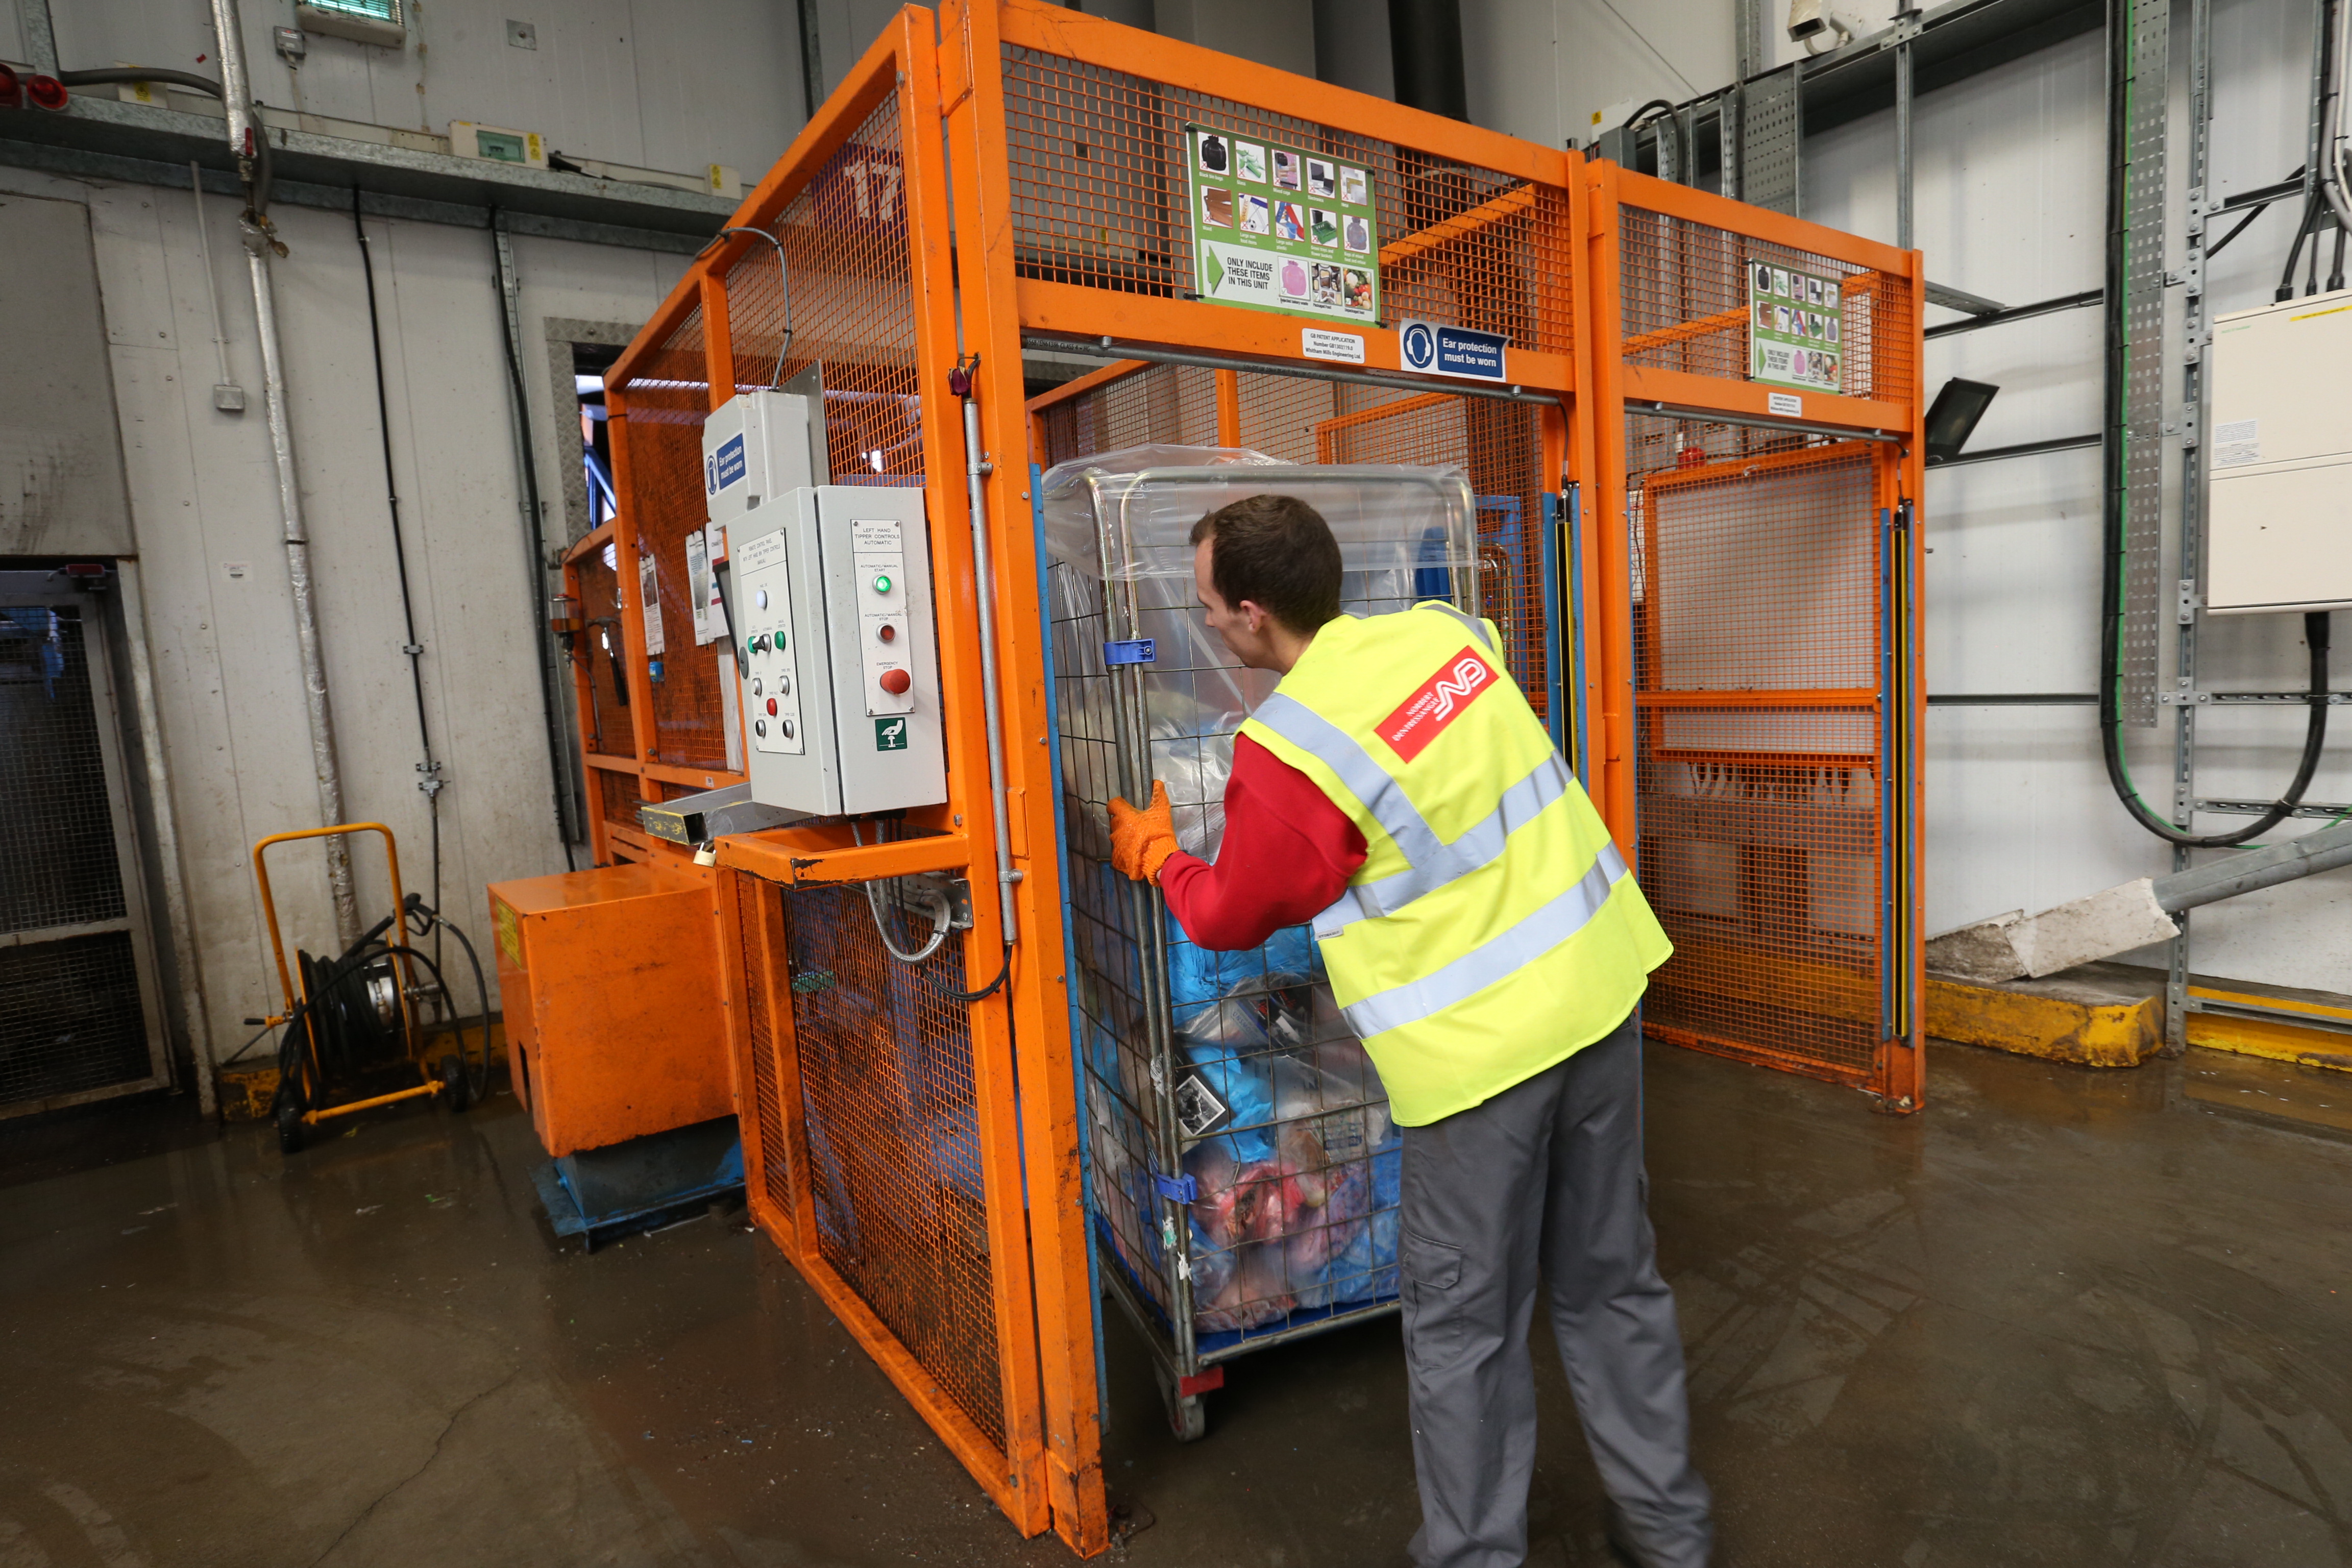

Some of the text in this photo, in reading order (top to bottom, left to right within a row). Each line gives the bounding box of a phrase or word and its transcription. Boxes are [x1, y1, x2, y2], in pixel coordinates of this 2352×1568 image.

[845, 160, 901, 222] 17
[1227, 257, 1272, 272] ONLY INCLUDE
[1228, 266, 1270, 280] THESE ITEMS
[1237, 278, 1252, 287] THIS
[1254, 281, 1268, 289] UNIT
[1442, 338, 1497, 354] Ear protection
[1444, 353, 1497, 366] must be worn
